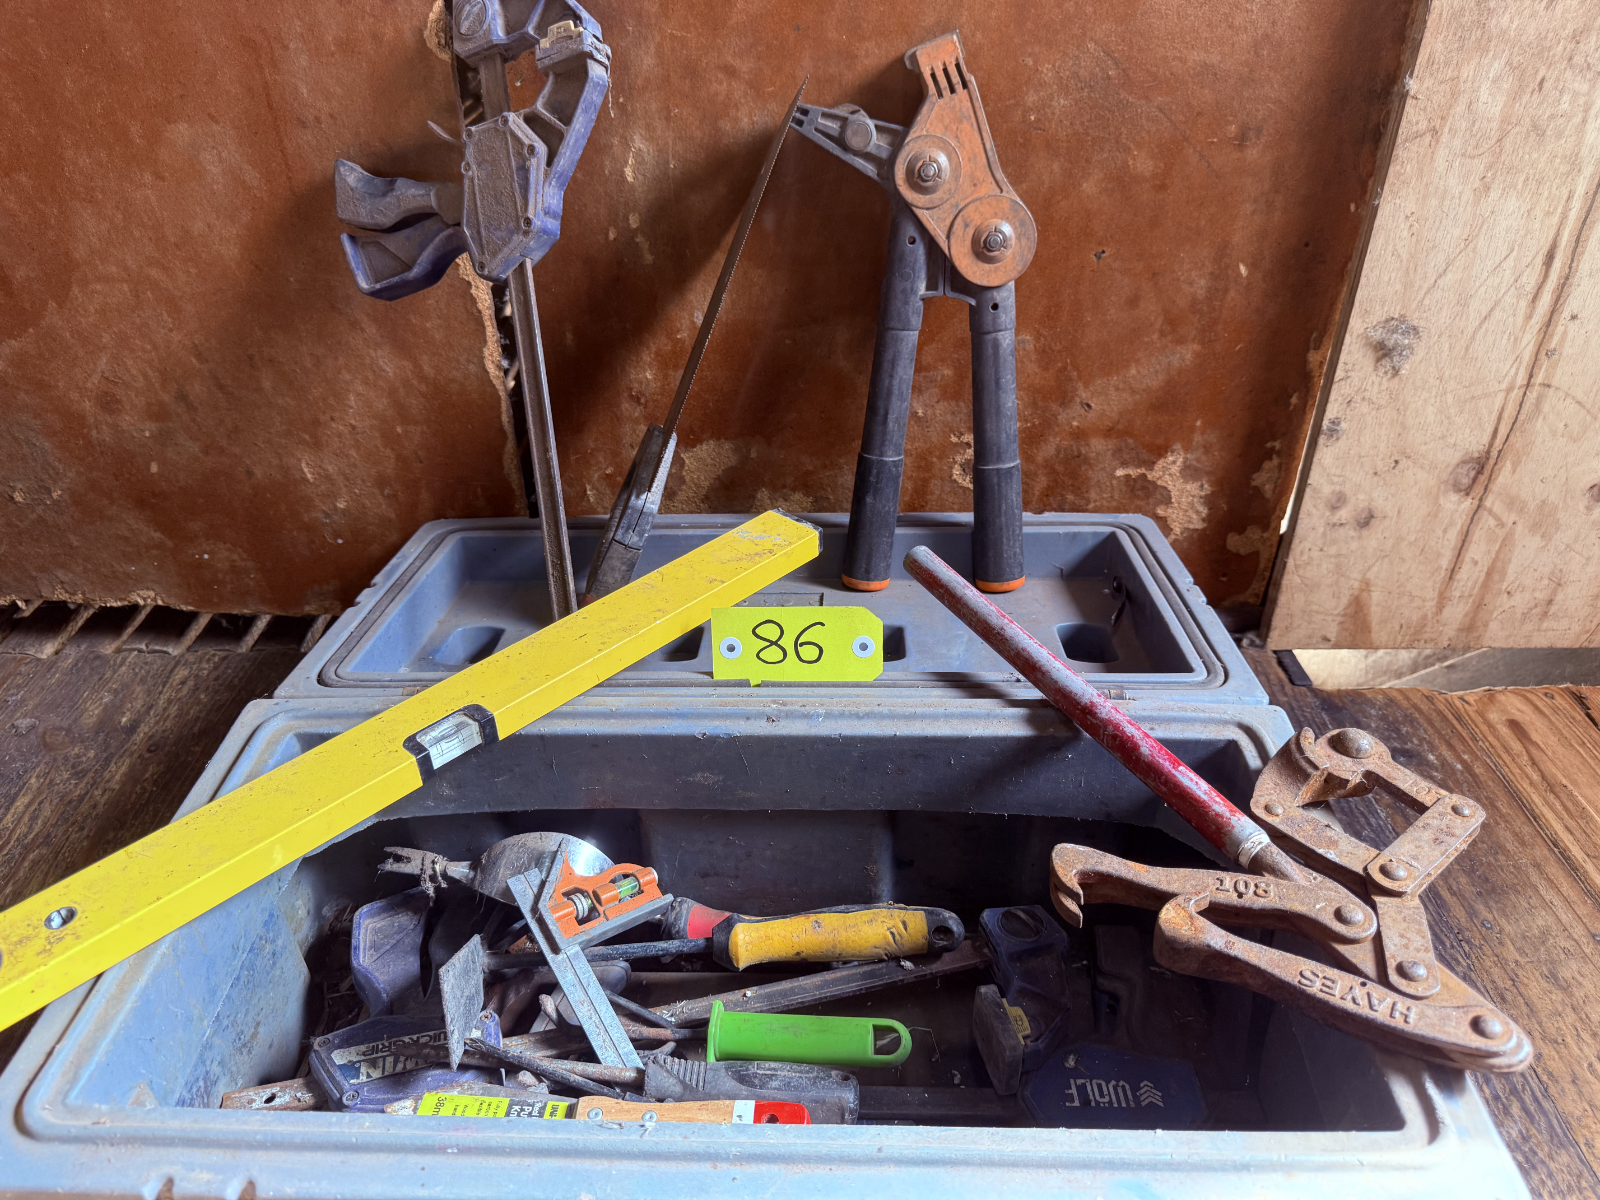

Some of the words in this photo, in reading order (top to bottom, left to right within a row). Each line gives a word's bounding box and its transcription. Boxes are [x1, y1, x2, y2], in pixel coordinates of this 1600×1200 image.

[752, 619, 826, 664] 86
[1216, 876, 1274, 898] 108
[1298, 968, 1416, 1025] HAYES
